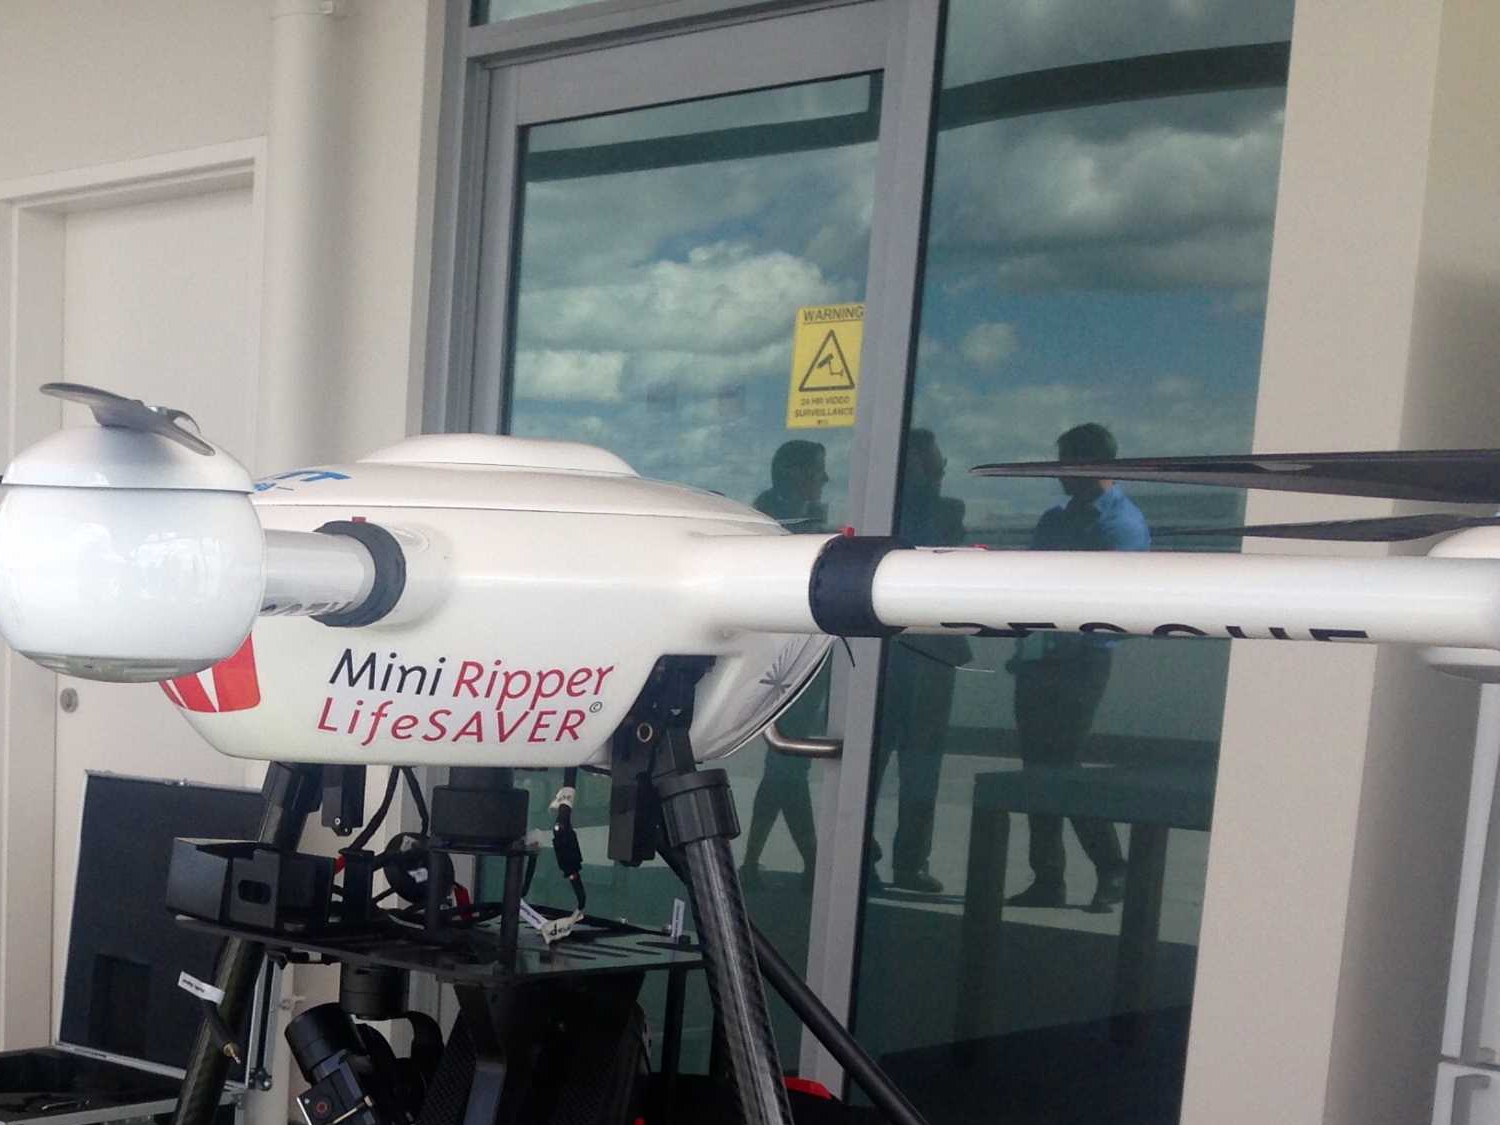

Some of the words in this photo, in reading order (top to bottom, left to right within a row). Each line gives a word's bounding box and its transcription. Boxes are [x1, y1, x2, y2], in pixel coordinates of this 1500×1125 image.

[803, 305, 865, 322] WARNING
[794, 407, 854, 418] SURVEILLANCE
[328, 647, 447, 697] Mini
[452, 658, 615, 712] Ripper
